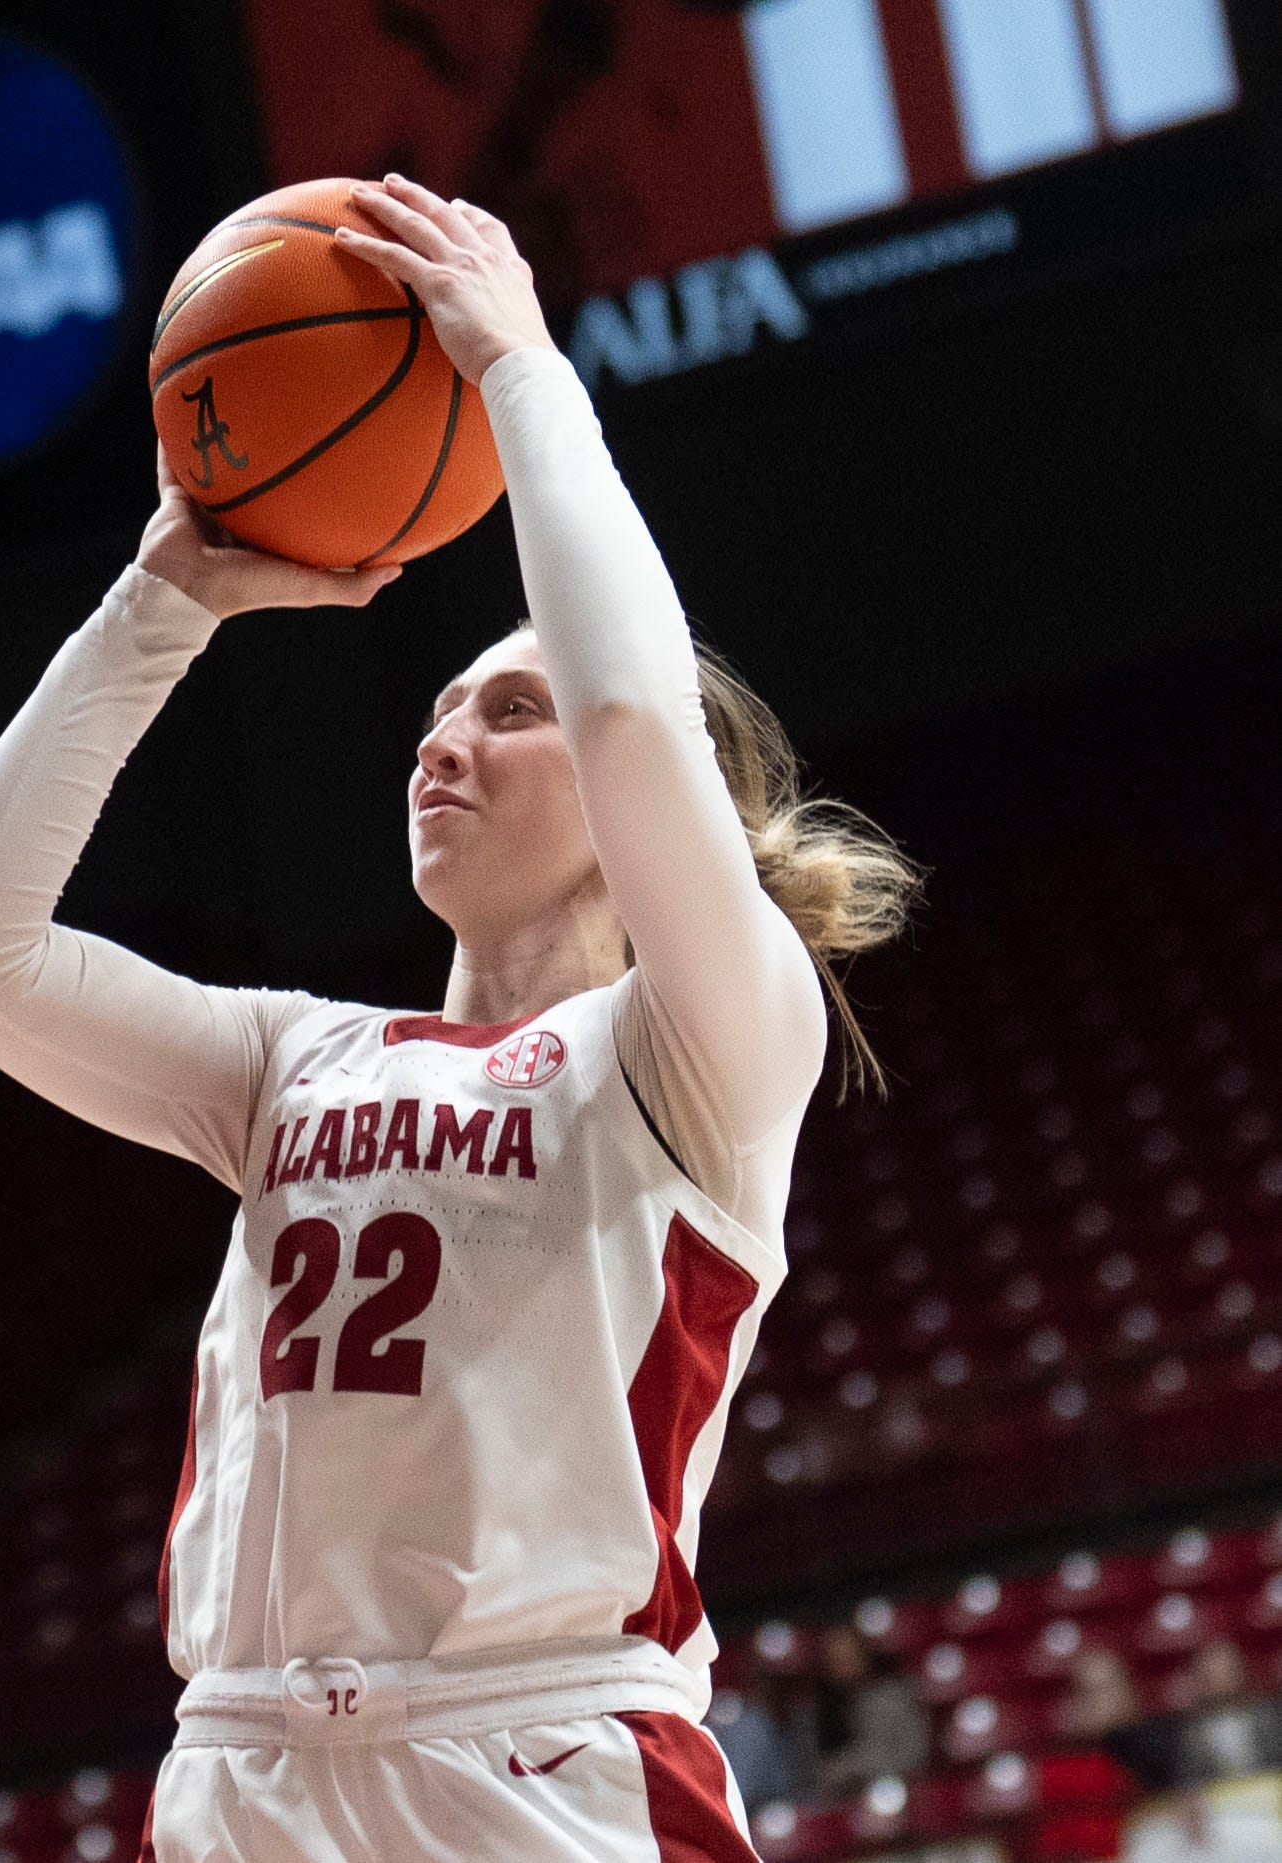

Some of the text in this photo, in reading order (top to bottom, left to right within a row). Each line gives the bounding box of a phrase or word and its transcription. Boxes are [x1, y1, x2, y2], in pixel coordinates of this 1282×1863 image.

[488, 1031, 564, 1083] SEC
[263, 1098, 538, 1194] ALABAMA
[259, 1211, 442, 1402] 22
